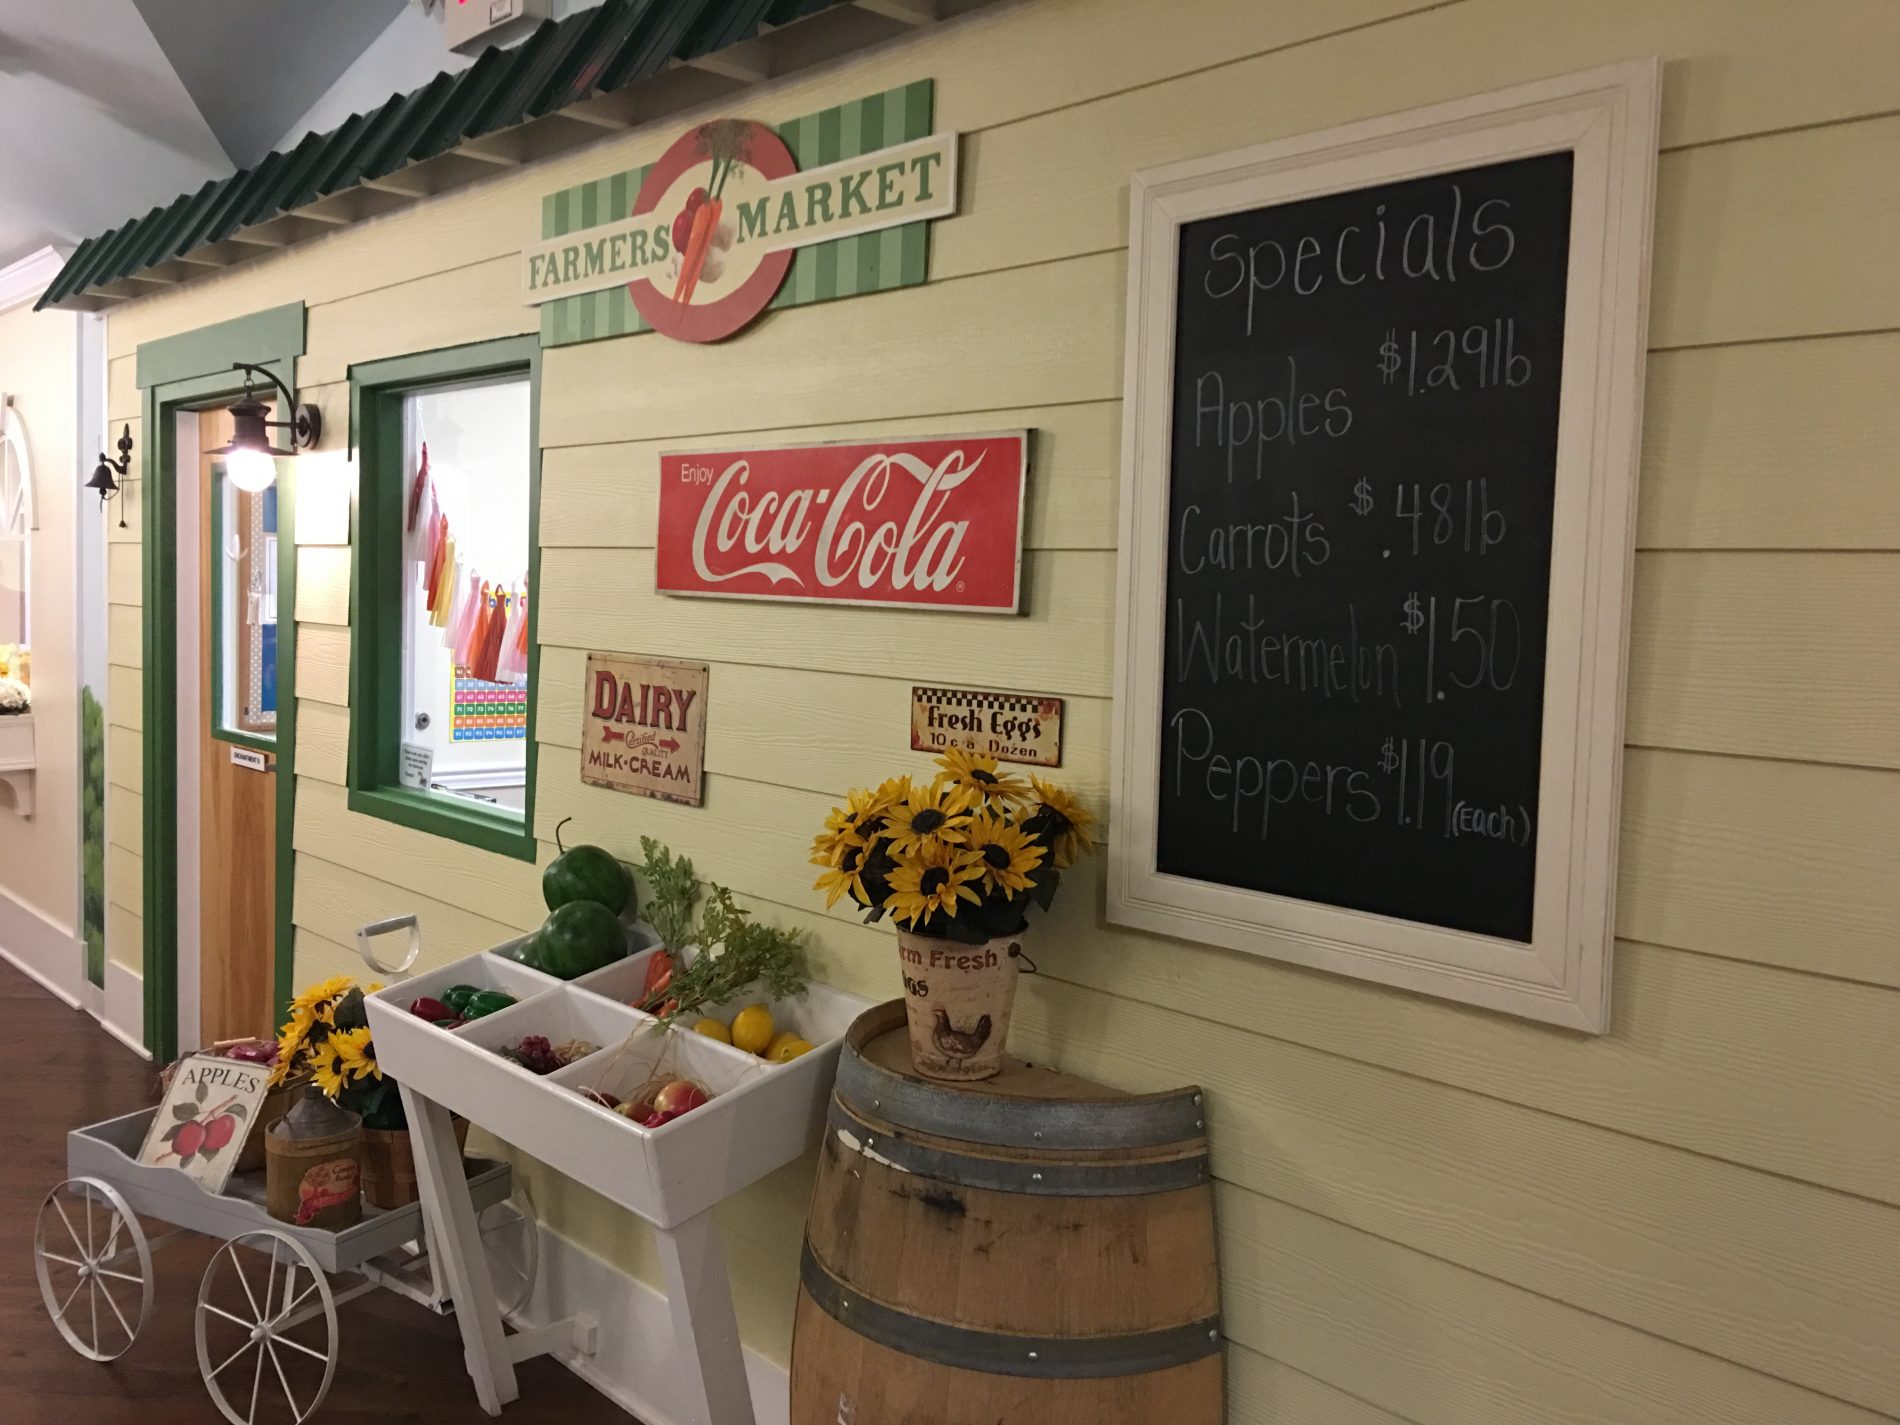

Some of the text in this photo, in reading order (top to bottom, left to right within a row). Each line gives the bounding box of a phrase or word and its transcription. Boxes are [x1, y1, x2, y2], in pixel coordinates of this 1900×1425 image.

[529, 151, 942, 290] FARMERS MARKET
[1204, 185, 1515, 336] Specials
[1195, 356, 1353, 482] Apples
[681, 463, 714, 486] Enjoy
[1179, 491, 1331, 577] Carrots
[1177, 592, 1401, 709] Watermelon
[592, 670, 697, 732] DAIRY
[990, 711, 1042, 742] Eggs
[641, 746, 669, 759] QUALITY
[988, 739, 1038, 758] Dozen
[1171, 708, 1381, 840] Peppers
[900, 946, 998, 970] rm Fresh
[182, 1067, 260, 1094] APPLES
